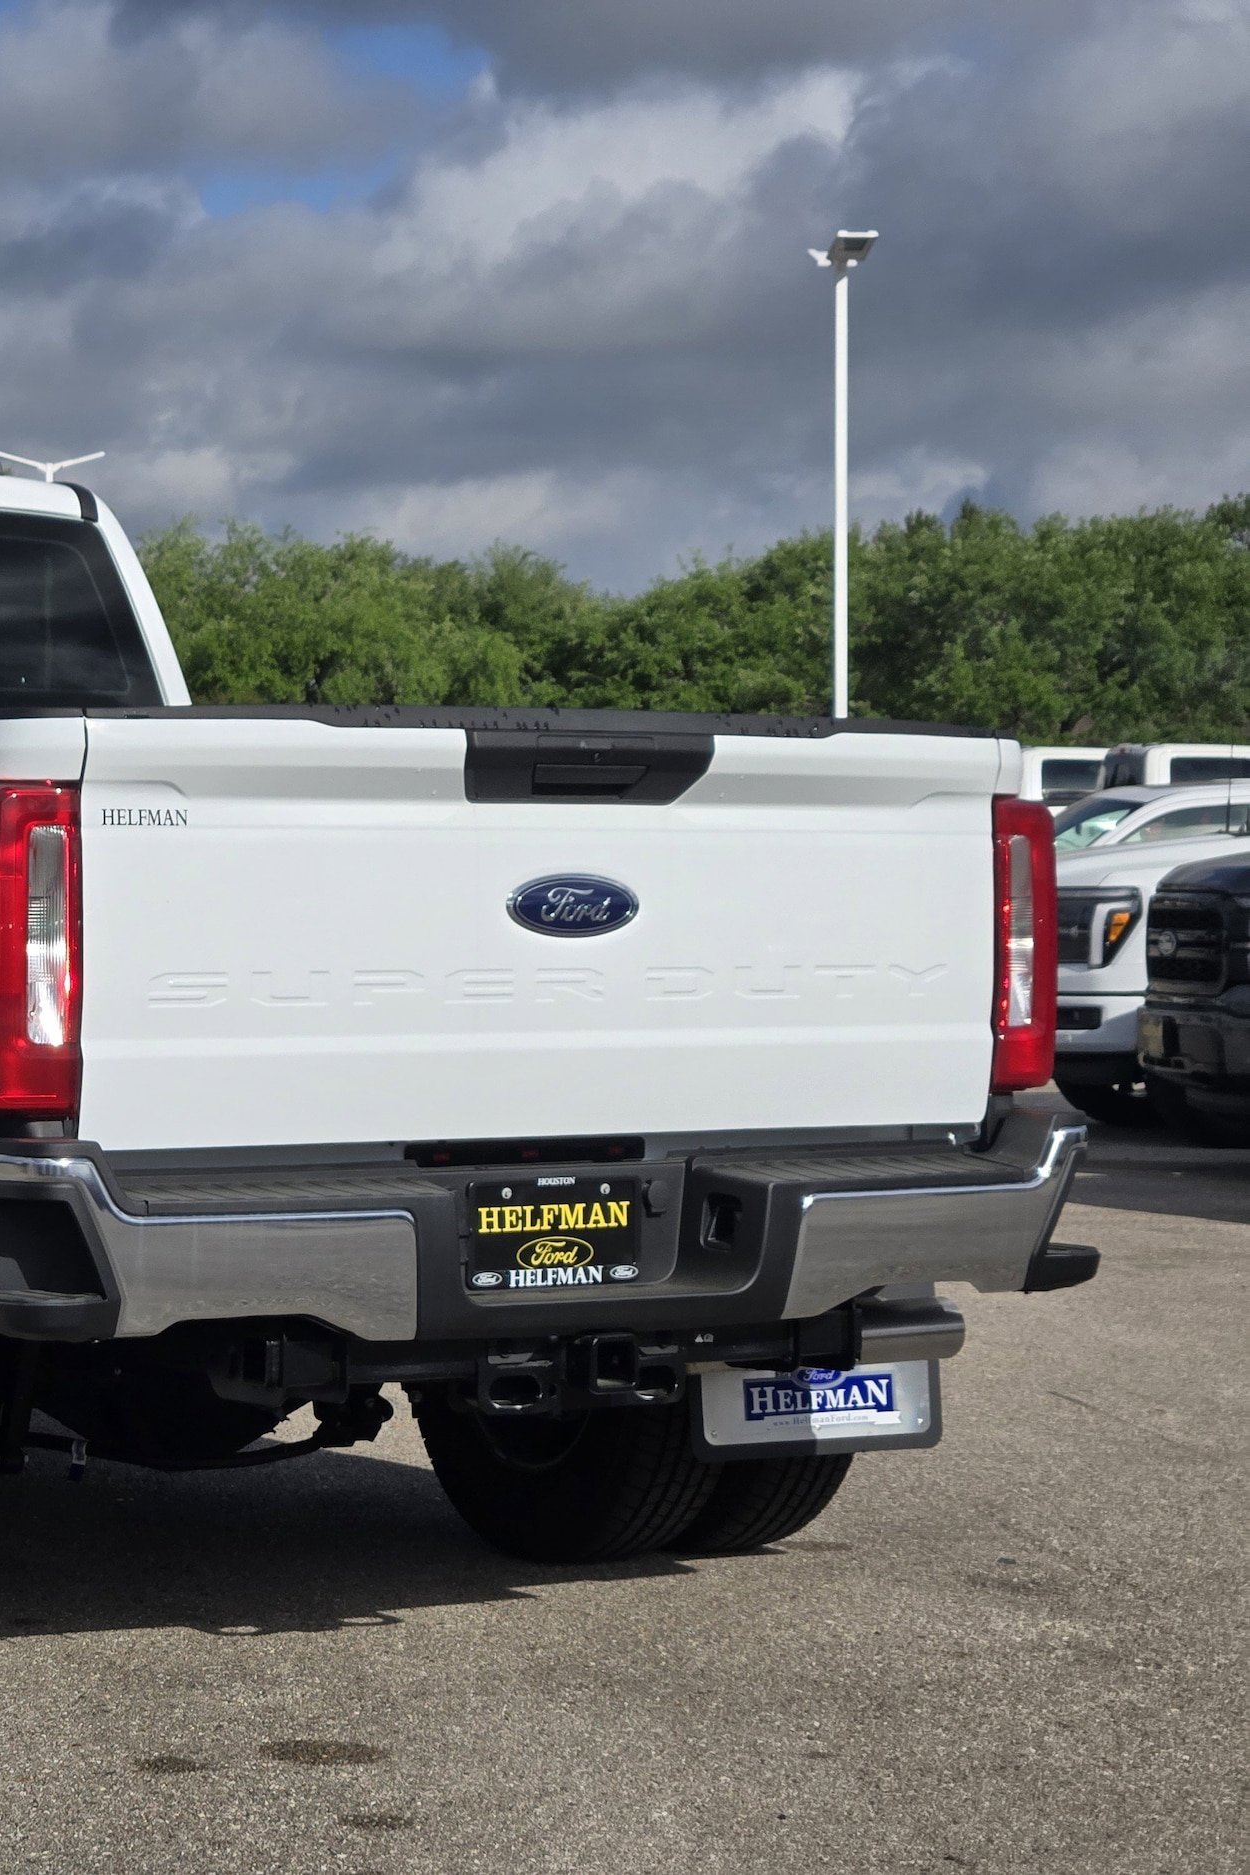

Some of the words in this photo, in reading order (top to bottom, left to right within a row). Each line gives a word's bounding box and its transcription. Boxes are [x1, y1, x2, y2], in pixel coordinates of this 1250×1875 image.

[101, 808, 188, 826] HELFMAN
[540, 886, 612, 922] Ford
[148, 967, 604, 1009] SUPER
[645, 963, 948, 1001] DUTY
[537, 1176, 576, 1187] HOUSTON
[477, 1200, 631, 1234] HELFMAN
[530, 1240, 578, 1265] Ford
[508, 1265, 604, 1289] HELFMAN
[803, 1368, 836, 1381] Ford
[749, 1378, 890, 1414] HELFMAN
